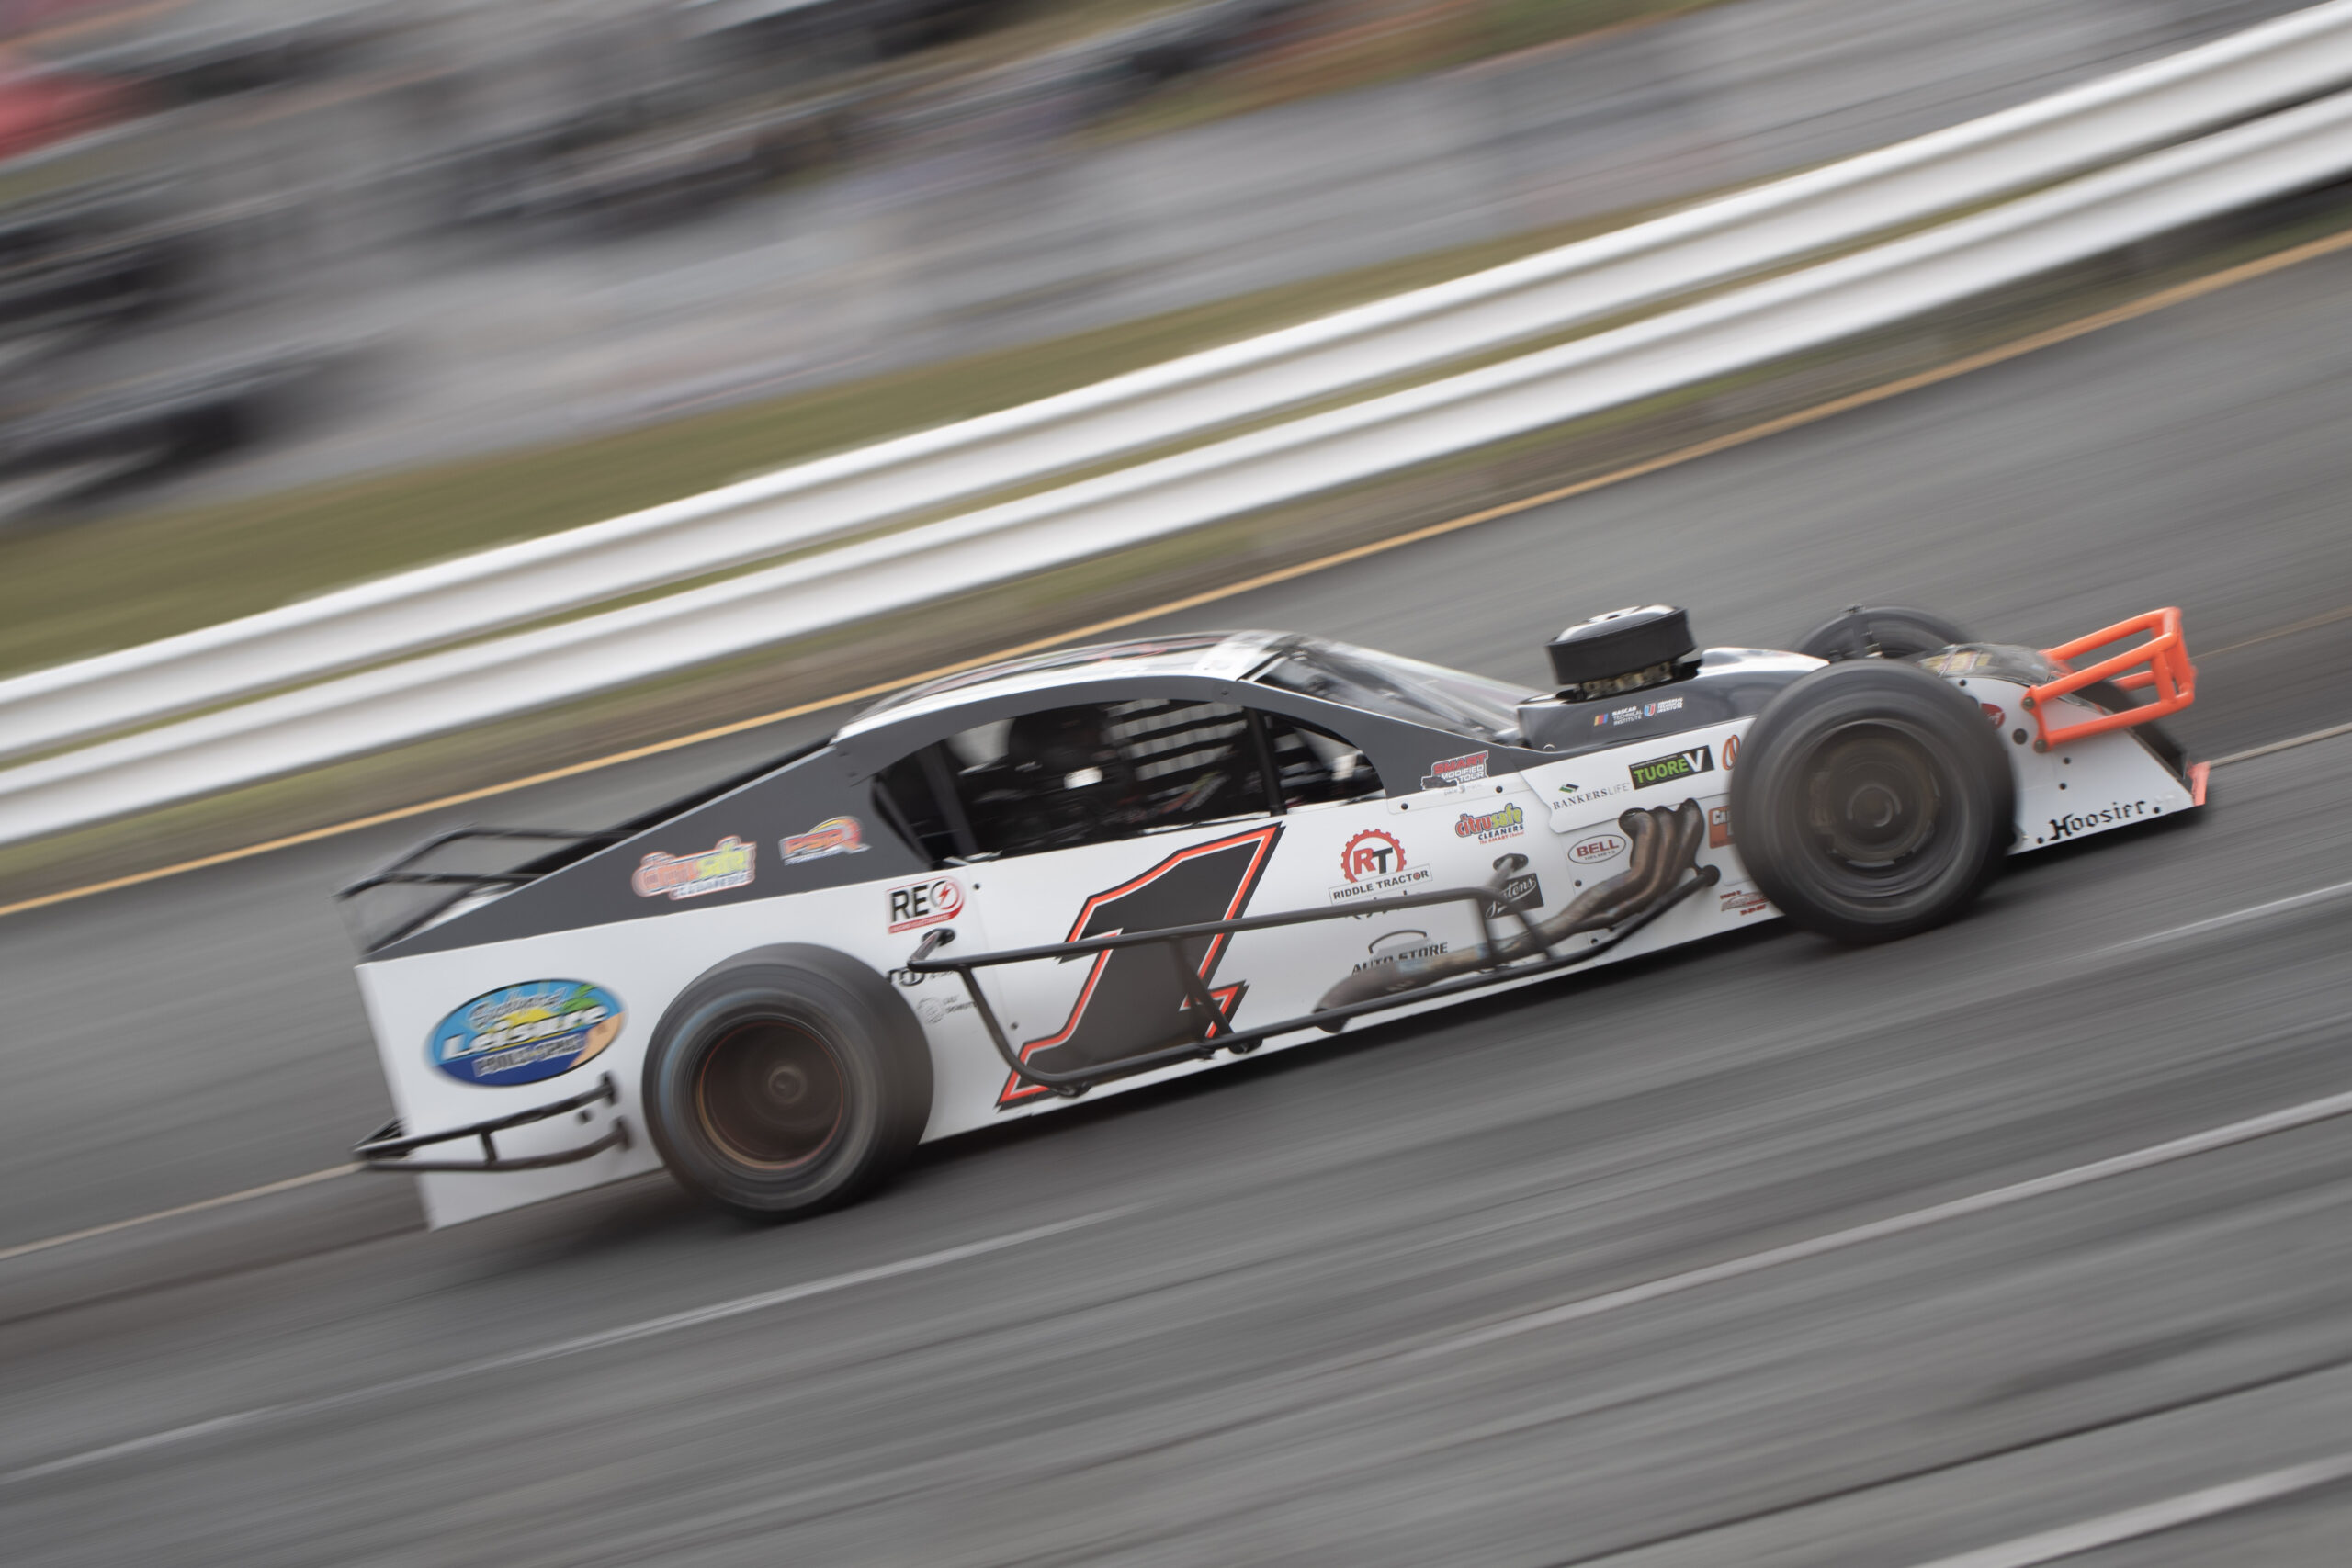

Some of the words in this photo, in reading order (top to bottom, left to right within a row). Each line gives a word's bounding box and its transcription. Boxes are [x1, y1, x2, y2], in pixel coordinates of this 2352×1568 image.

[1611, 705, 1637, 716] NASCAR
[1433, 752, 1487, 775] SMART
[1441, 763, 1484, 780] MODIFIED
[1459, 771, 1484, 783] TOUR
[1455, 803, 1523, 838] citrusafe
[1478, 824, 1524, 840] CLEANERS
[2048, 798, 2146, 842] Hoosier
[1352, 847, 1394, 875] RT
[1576, 839, 1620, 858] BELL
[1333, 882, 1374, 900] RIDDLE
[1375, 869, 1430, 890] TRACTOR
[994, 819, 1286, 1113] 1
[440, 1005, 610, 1061] Leisure
